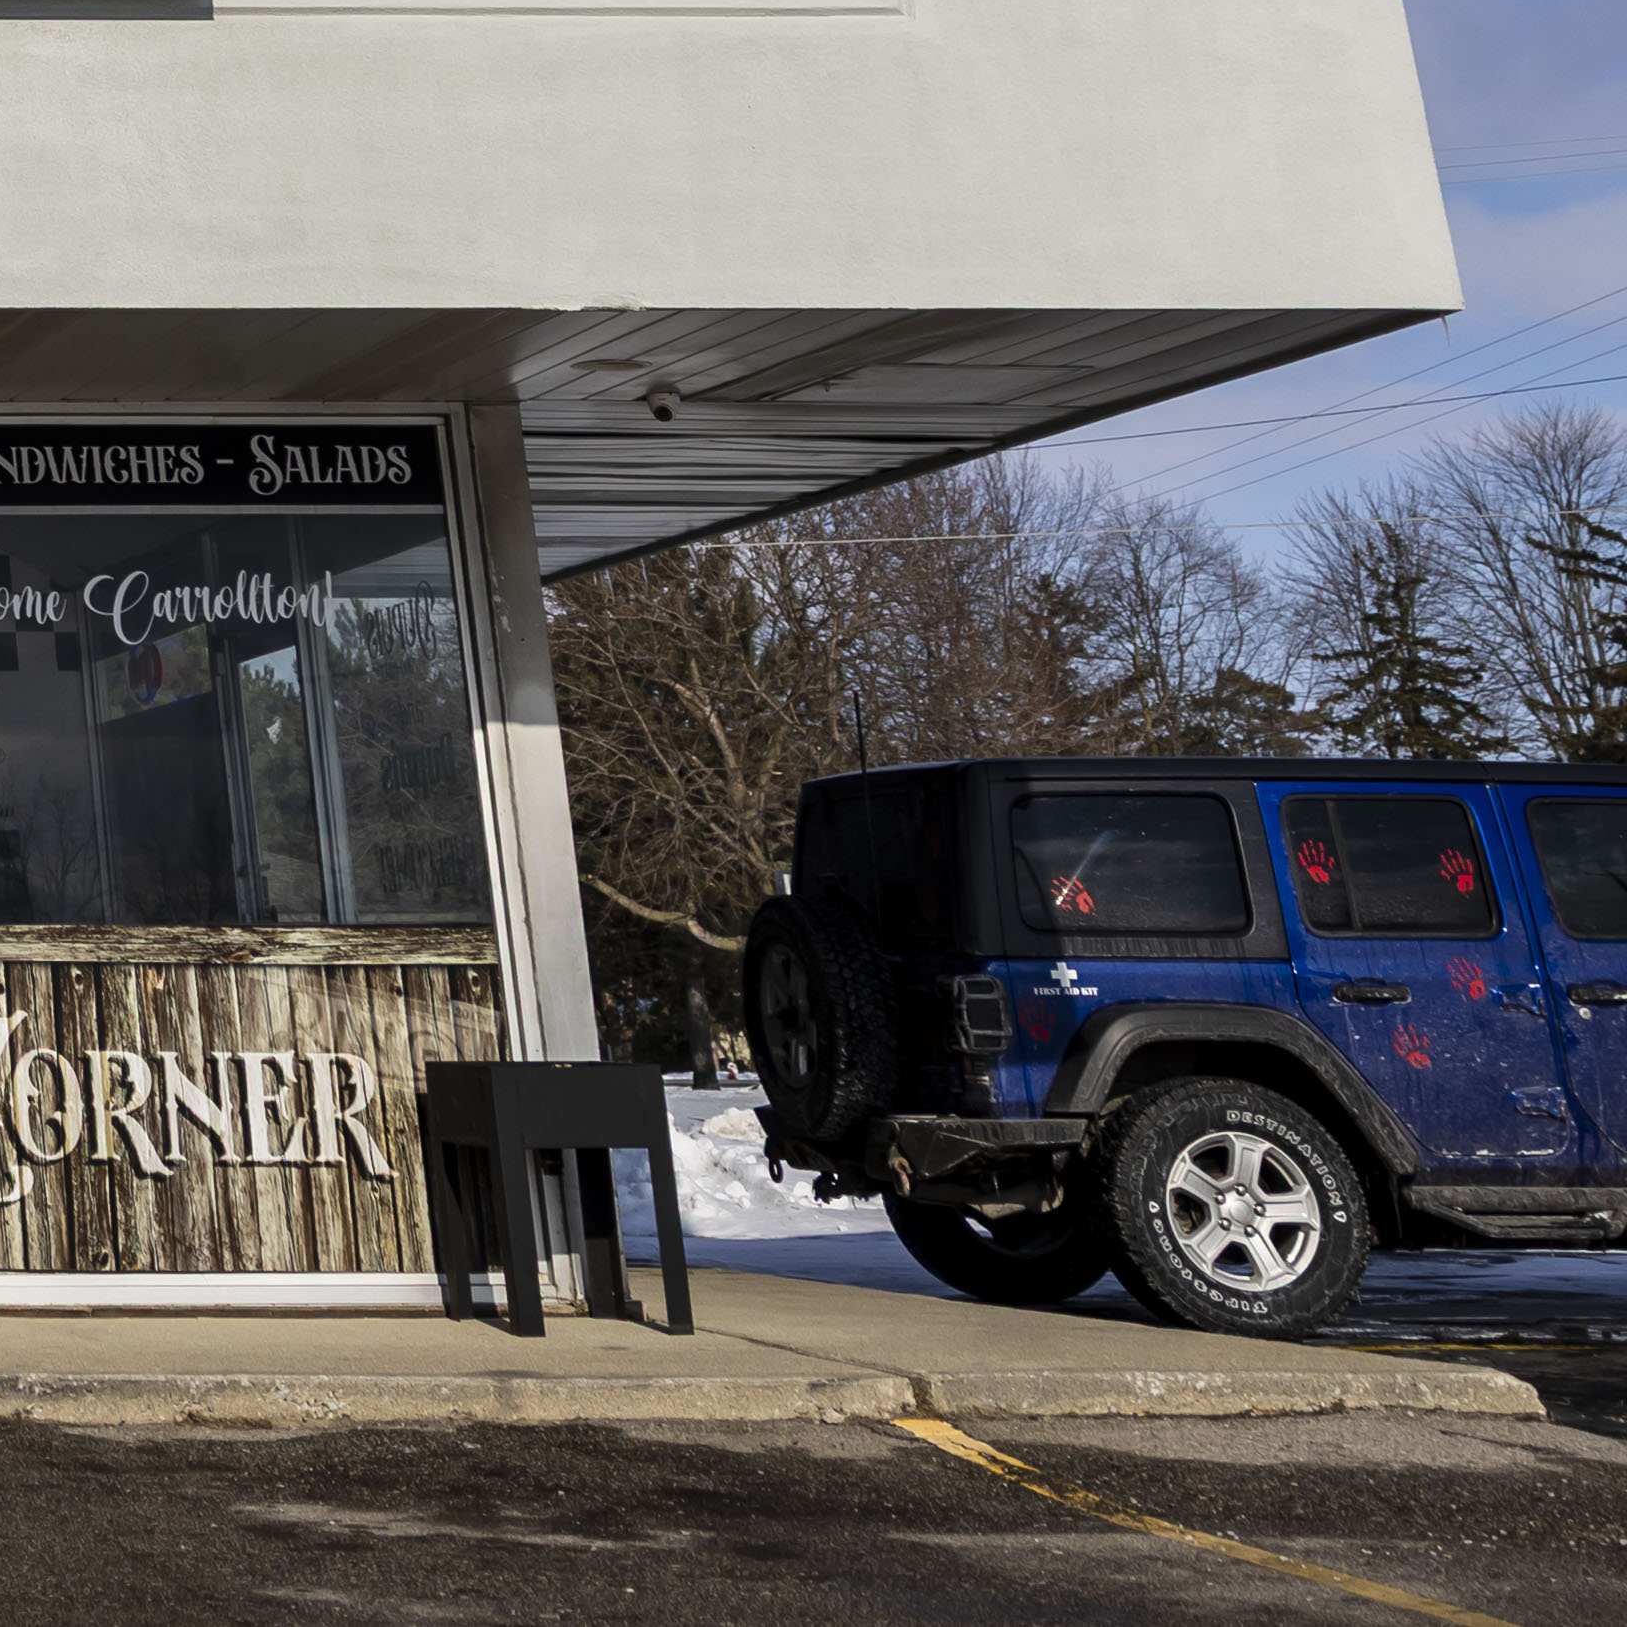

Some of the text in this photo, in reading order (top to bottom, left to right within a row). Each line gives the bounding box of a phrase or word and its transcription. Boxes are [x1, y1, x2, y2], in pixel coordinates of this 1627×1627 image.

[1033, 987, 1099, 996] FIRST AID KIT
[1227, 1110, 1342, 1205] DESTINATION
